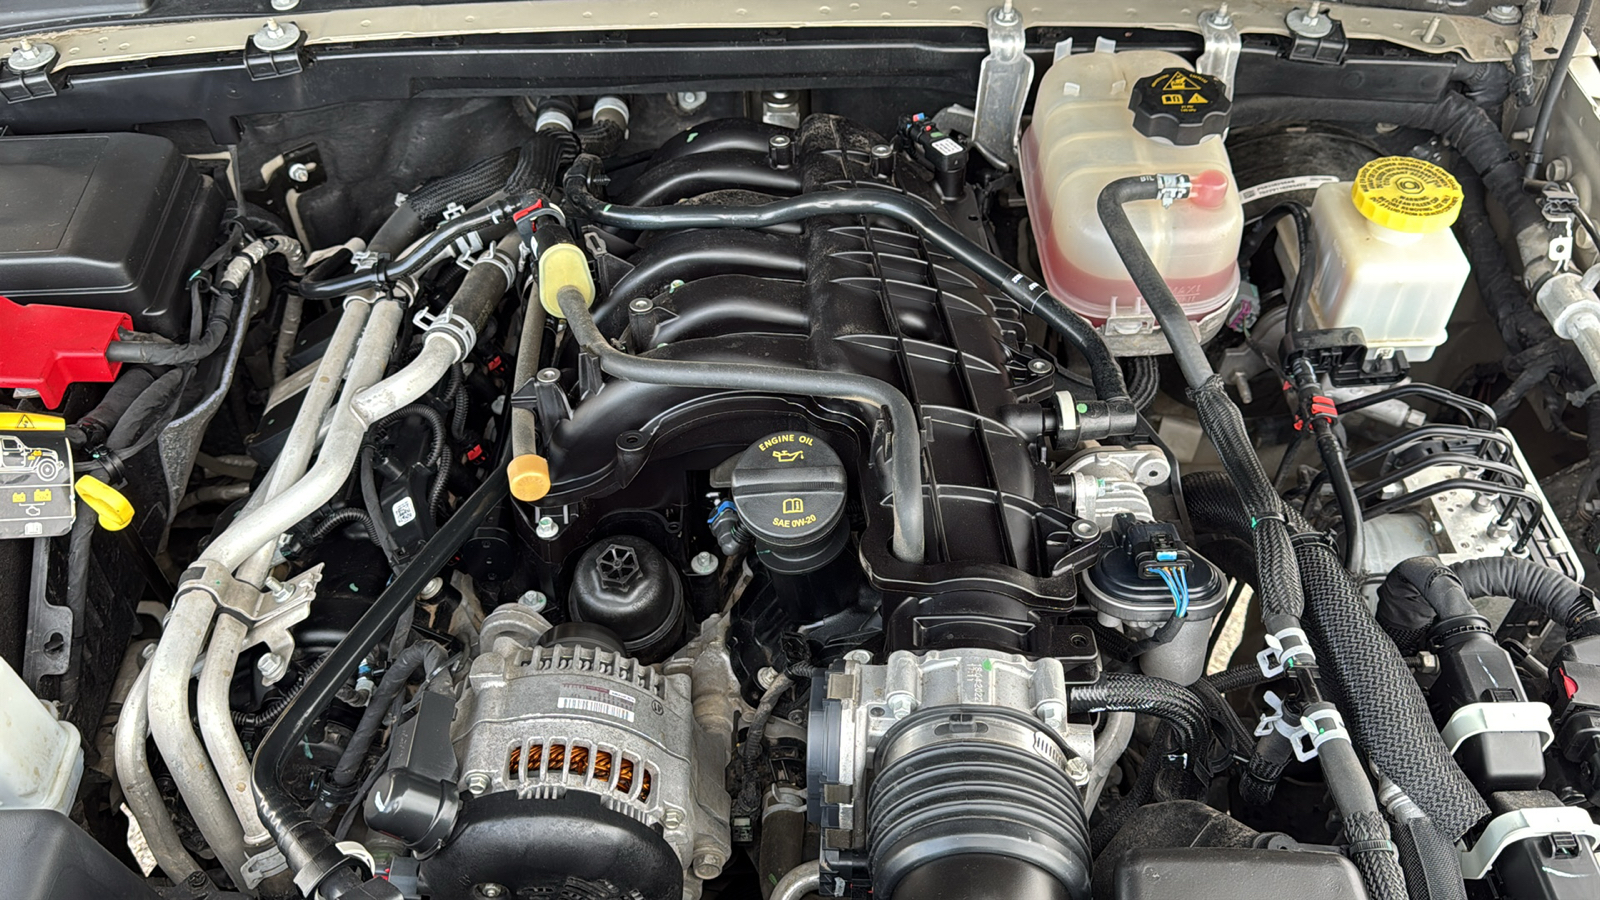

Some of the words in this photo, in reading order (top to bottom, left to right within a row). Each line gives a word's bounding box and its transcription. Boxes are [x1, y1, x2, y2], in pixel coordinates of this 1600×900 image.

[758, 434, 795, 452] ENGINE
[798, 435, 814, 447] OIL
[772, 517, 790, 528] SAE
[791, 514, 817, 528] 0W-20
